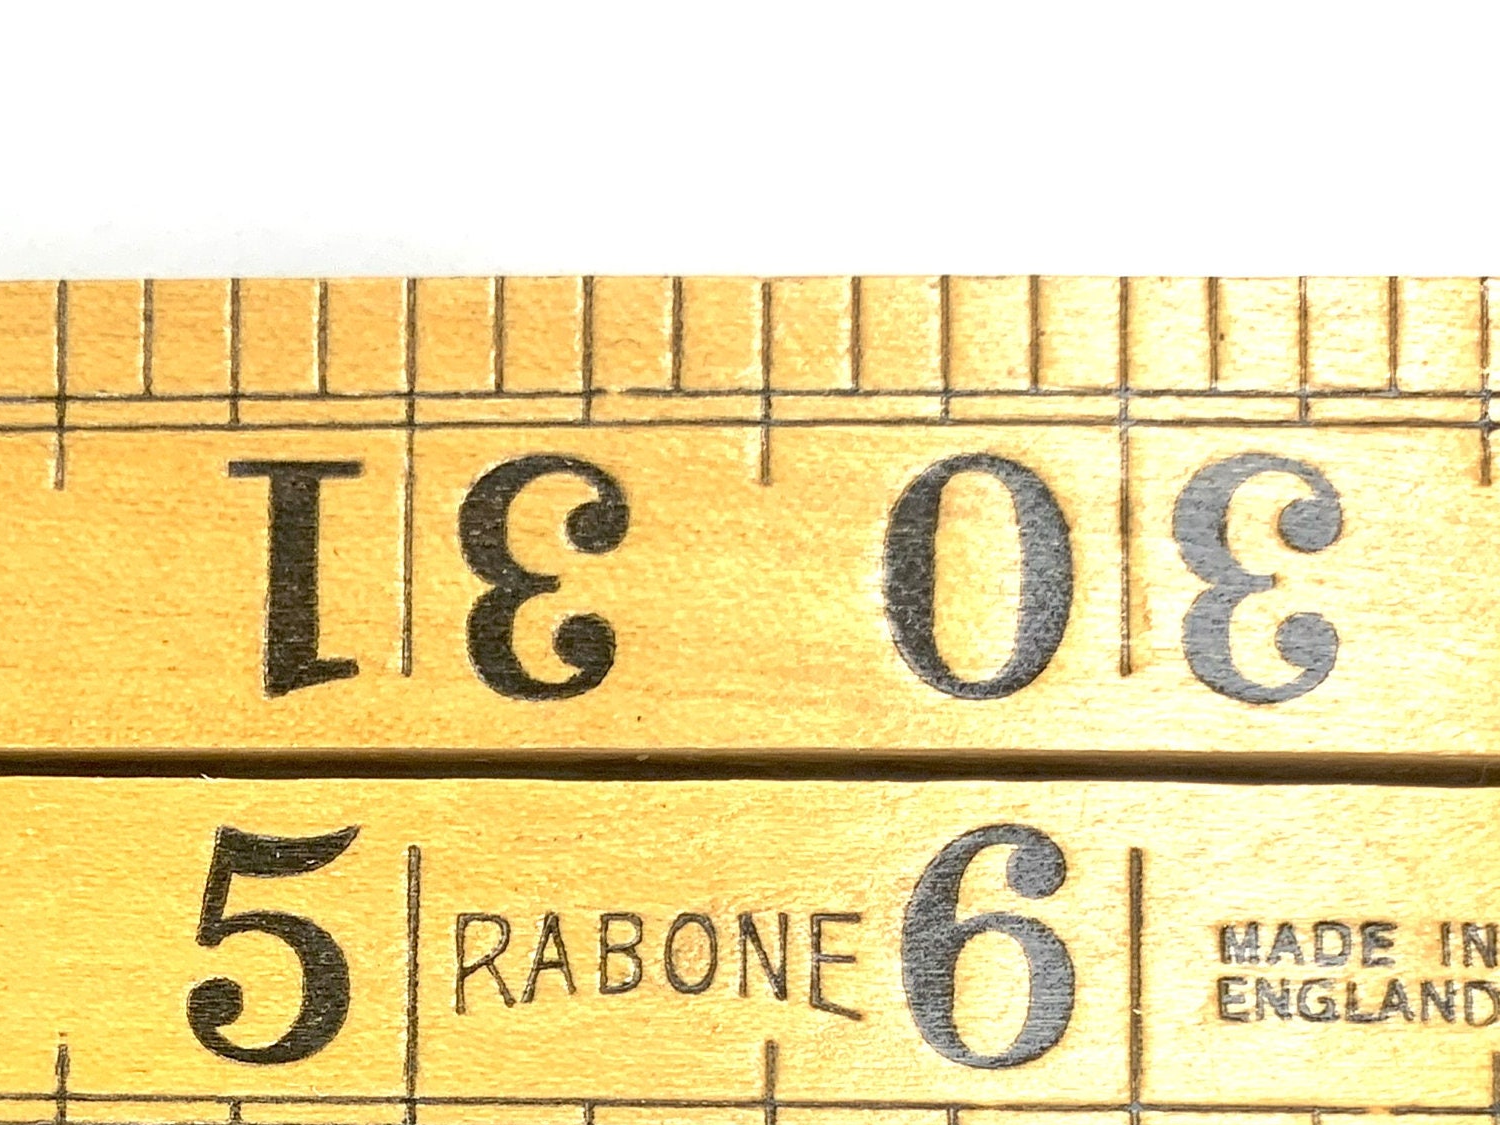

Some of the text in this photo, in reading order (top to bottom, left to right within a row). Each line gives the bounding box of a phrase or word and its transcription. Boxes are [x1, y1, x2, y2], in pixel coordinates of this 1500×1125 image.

[186, 824, 362, 1067] 5
[454, 910, 865, 1022] RABONE
[900, 822, 1077, 1071] 6
[1217, 919, 1500, 970] MADE IN
[1216, 975, 1500, 1028] ENGLAND
